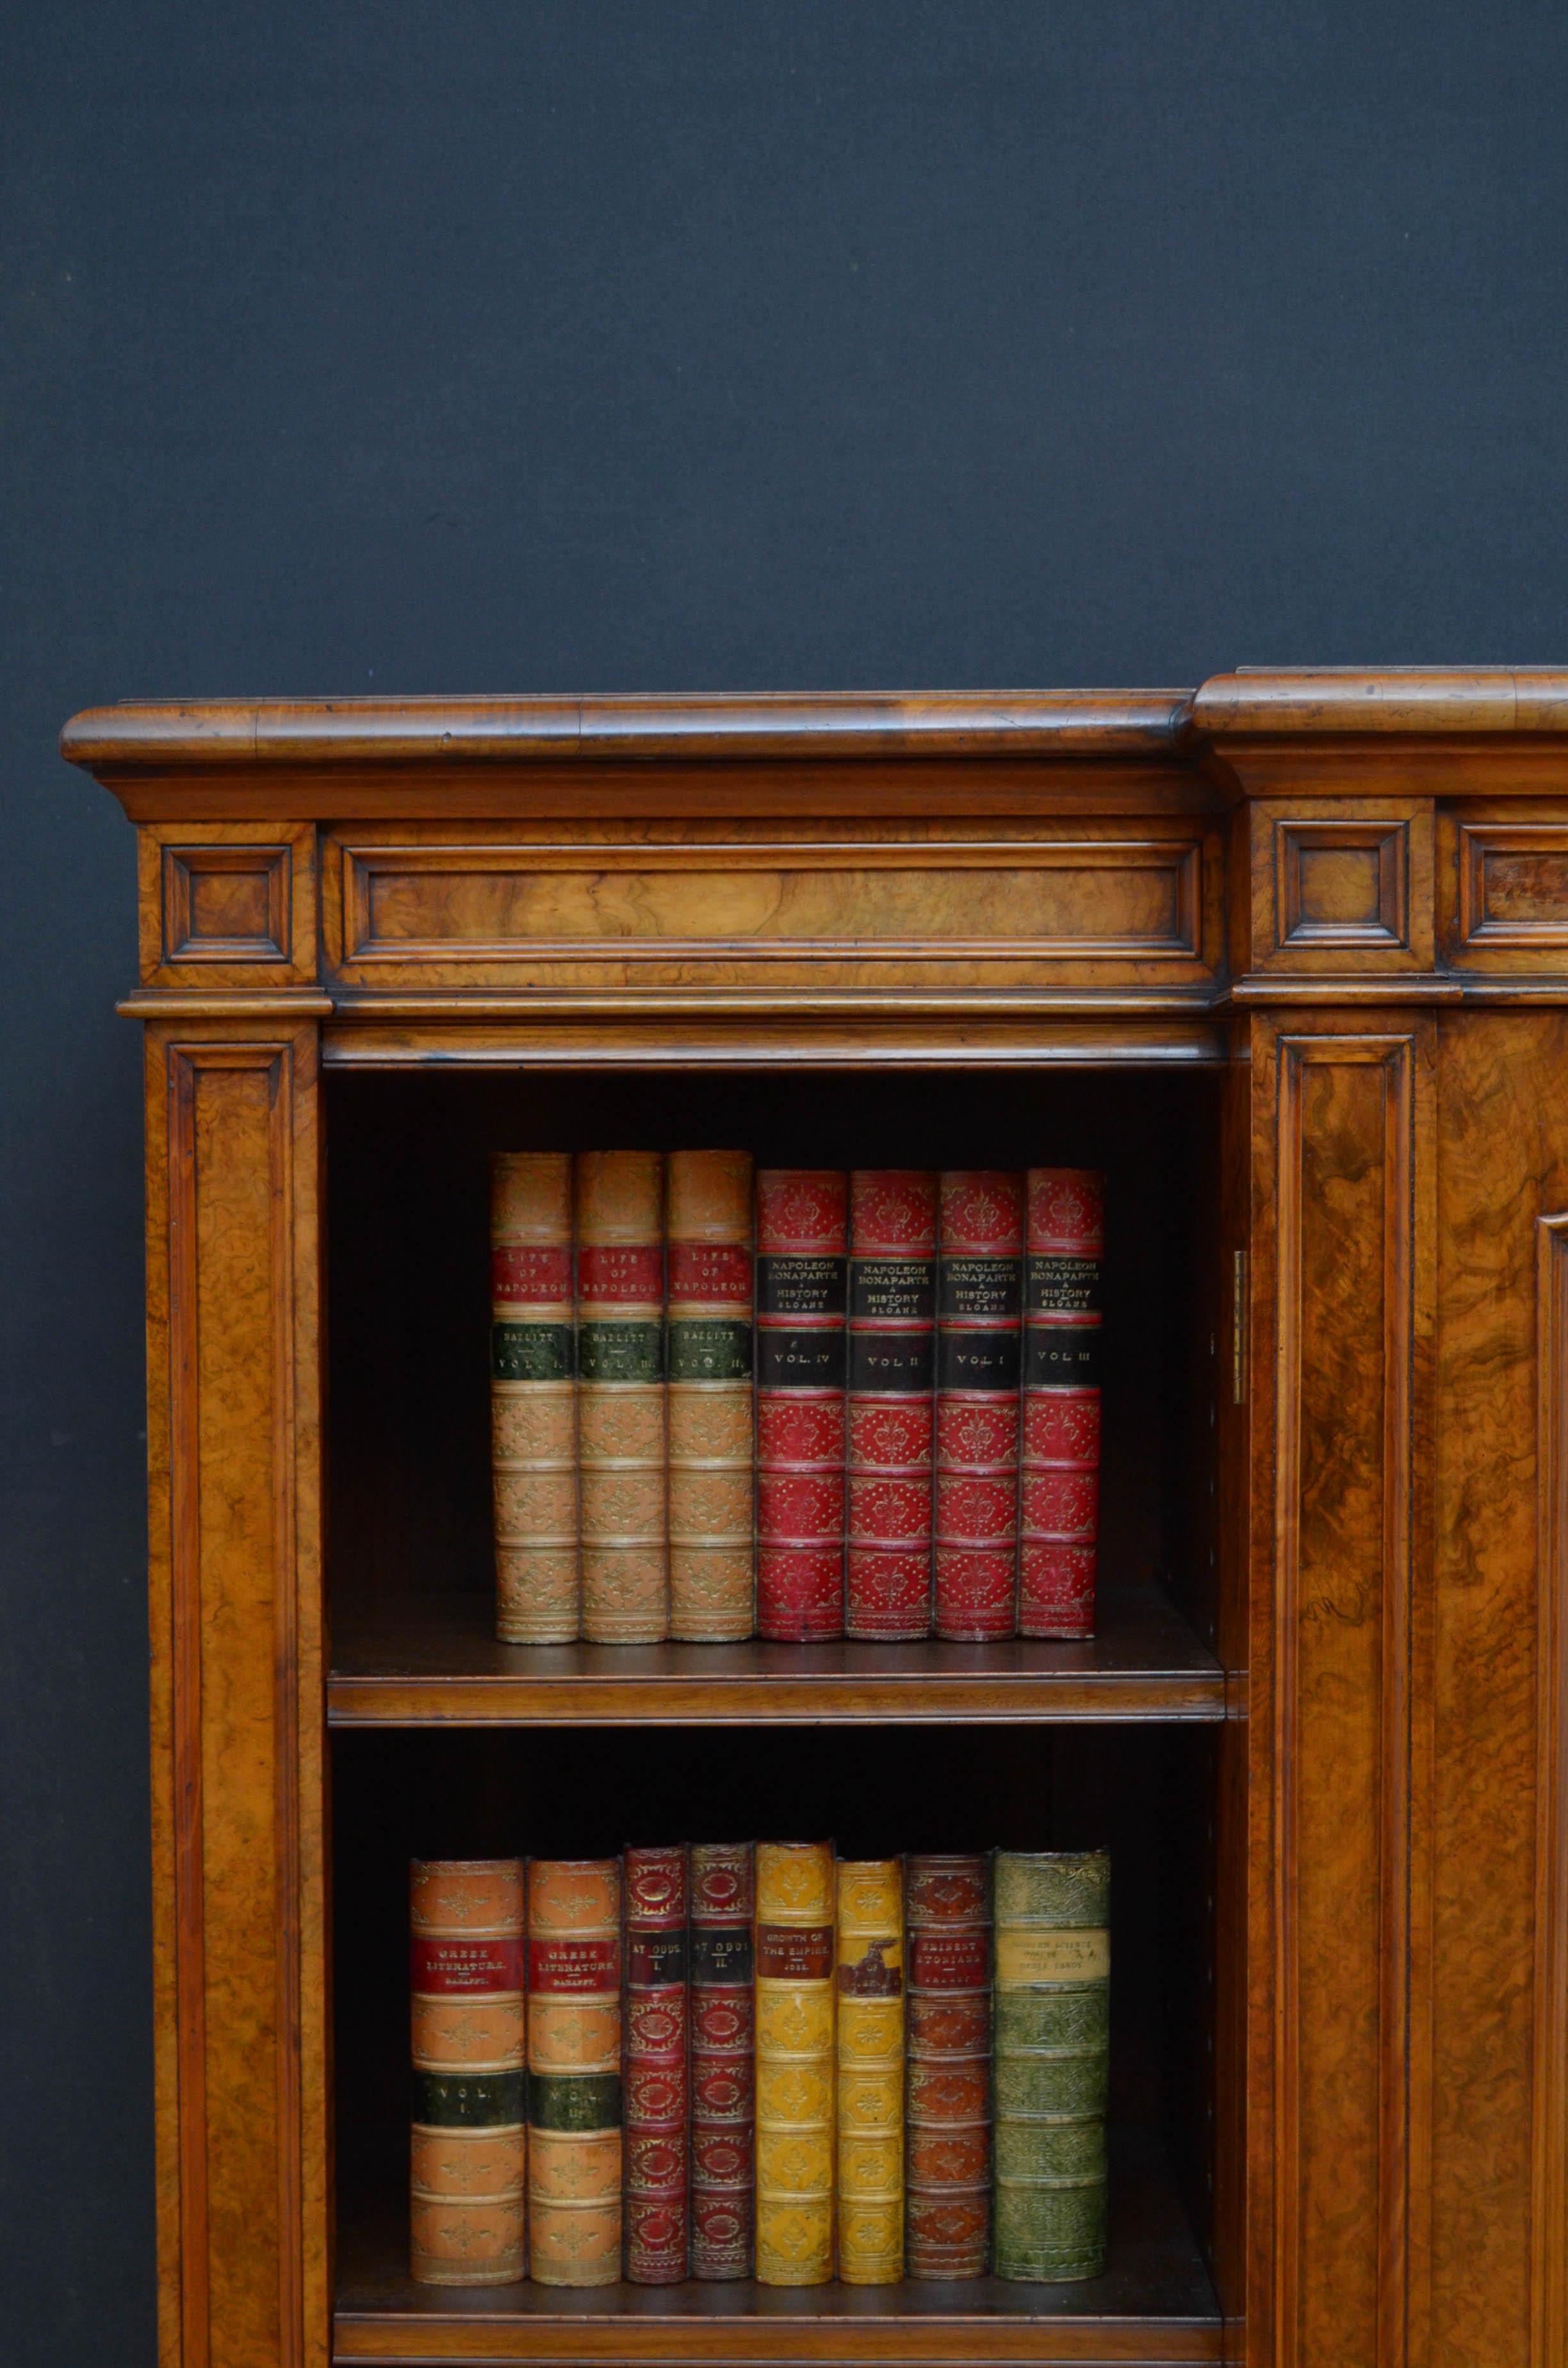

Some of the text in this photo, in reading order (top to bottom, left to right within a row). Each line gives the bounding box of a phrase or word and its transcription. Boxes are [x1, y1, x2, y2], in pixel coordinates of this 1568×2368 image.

[508, 1254, 548, 1263] LIFE
[600, 1255, 637, 1264] LIFE
[692, 1252, 729, 1261] LIFE
[864, 1266, 926, 1274] NAPOLEON
[952, 1263, 1013, 1272] NAPOLEON
[1036, 1262, 1096, 1270] NAPOLEON
[611, 1269, 627, 1278] OF
[702, 1267, 718, 1276] OF
[769, 1272, 838, 1280] BONAPARTE
[859, 1276, 929, 1285] BONAPARTE
[947, 1274, 1015, 1282] BONAPARTE
[496, 1283, 568, 1292] NAPOLEON
[584, 1283, 655, 1292] NAPOLEON
[674, 1282, 746, 1291] NAPOLEON
[777, 1290, 828, 1298] HISTORY
[956, 1291, 1006, 1299] HISTORY
[868, 1295, 919, 1303] HISTORY
[503, 1333, 553, 1342] HAZLITT
[592, 1333, 644, 1342] HAZLITT
[683, 1331, 735, 1340] HAZLITT
[767, 1934, 823, 1943] GROWTH OF
[633, 1945, 644, 1953] AT
[763, 1946, 784, 1955] THE
[922, 1943, 977, 1952] EMINENT
[916, 1955, 980, 1964] ETONIANS
